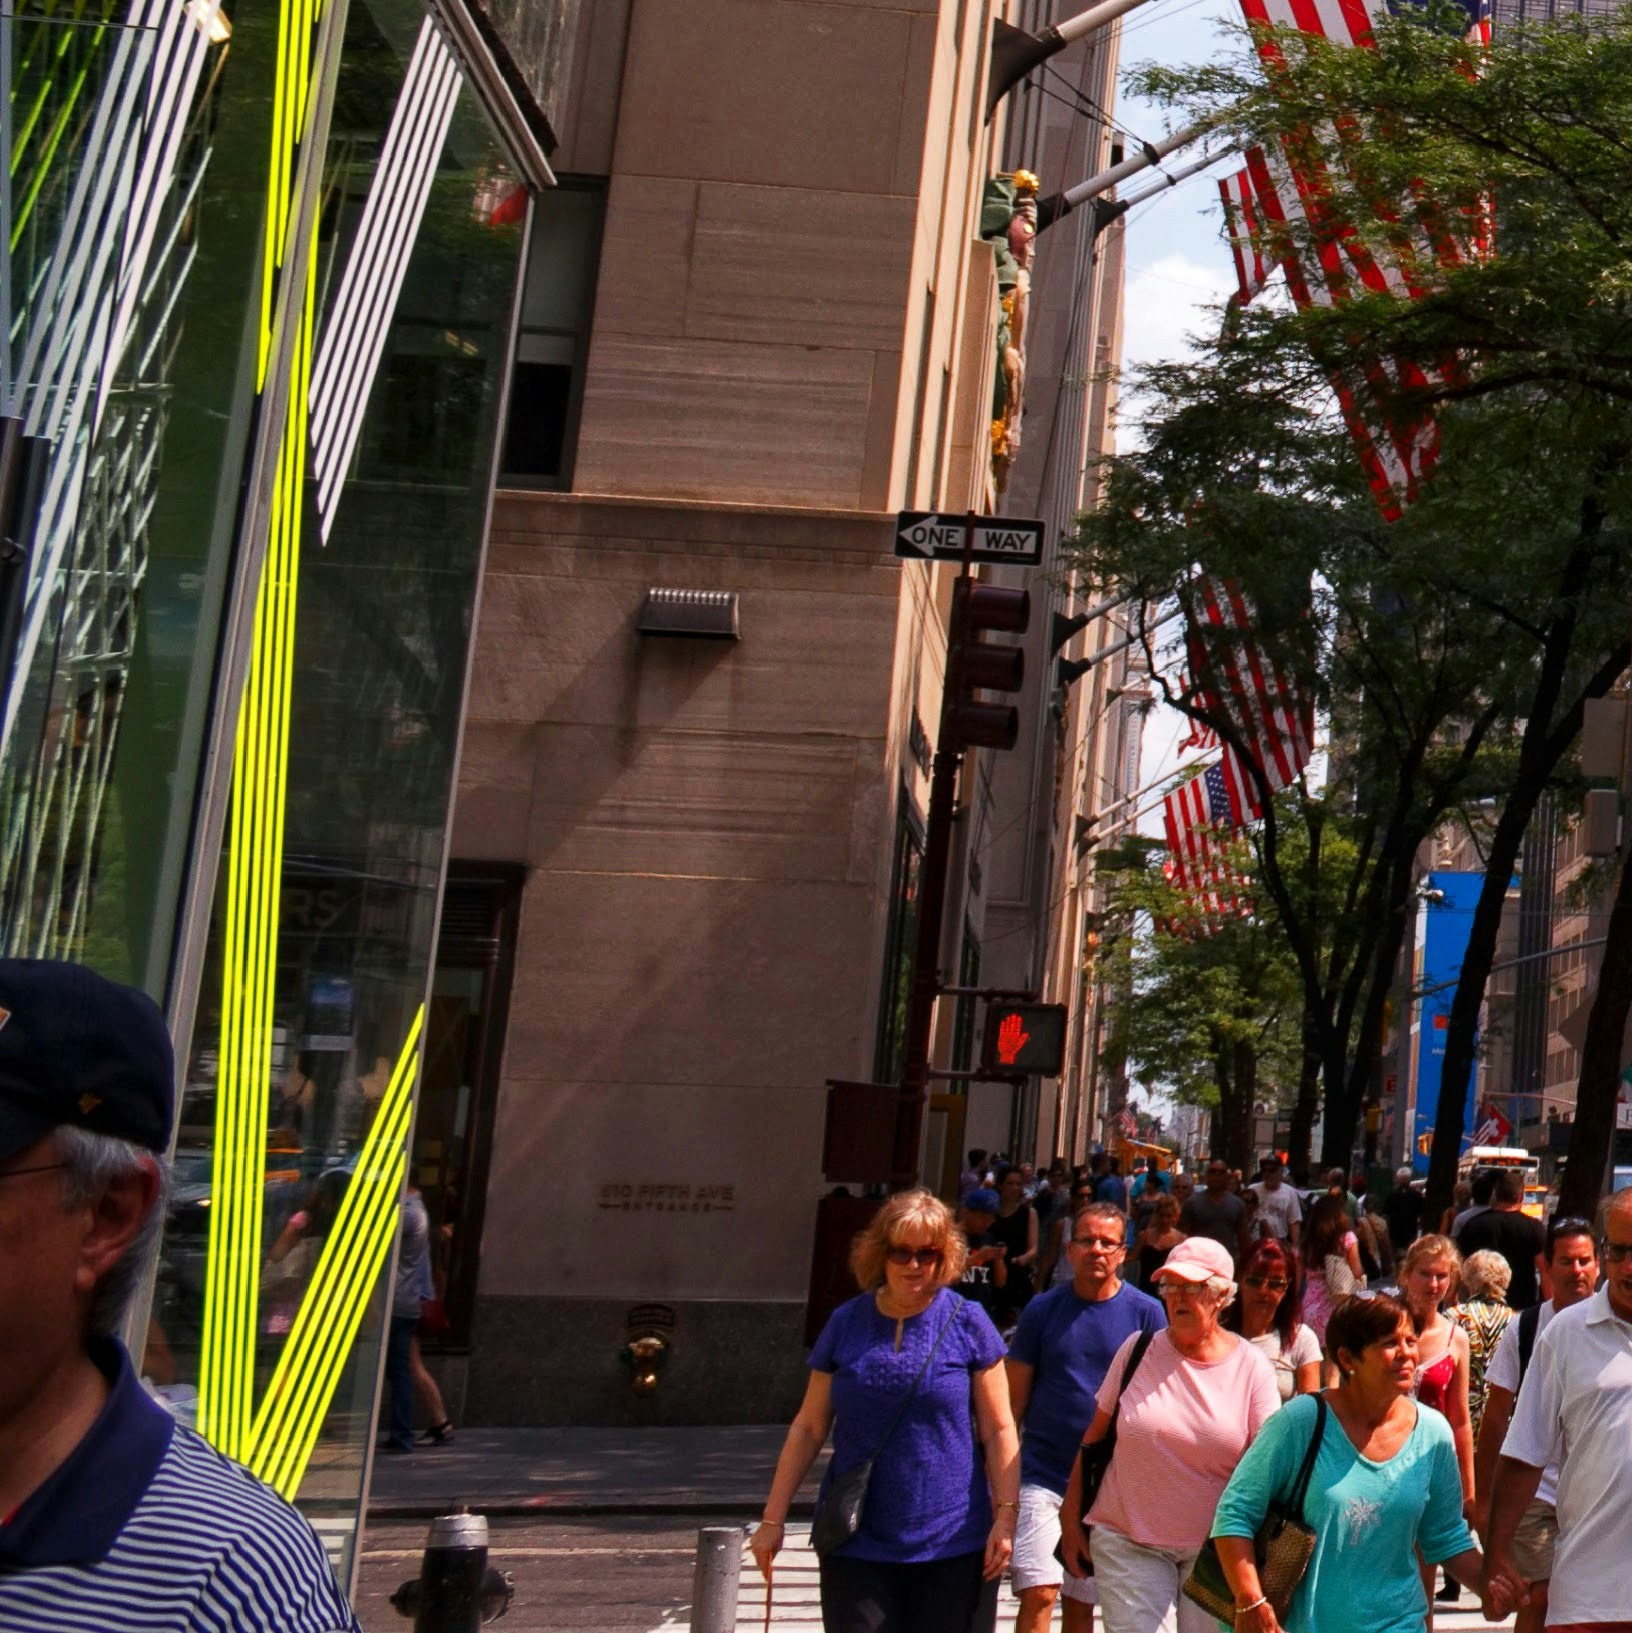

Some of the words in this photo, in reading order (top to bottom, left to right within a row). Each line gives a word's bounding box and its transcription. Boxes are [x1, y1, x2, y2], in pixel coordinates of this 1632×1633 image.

[912, 526, 959, 547] ONE
[985, 530, 1032, 551] WAY
[639, 1183, 690, 1200] FIFTH
[695, 1184, 736, 1201] AVE
